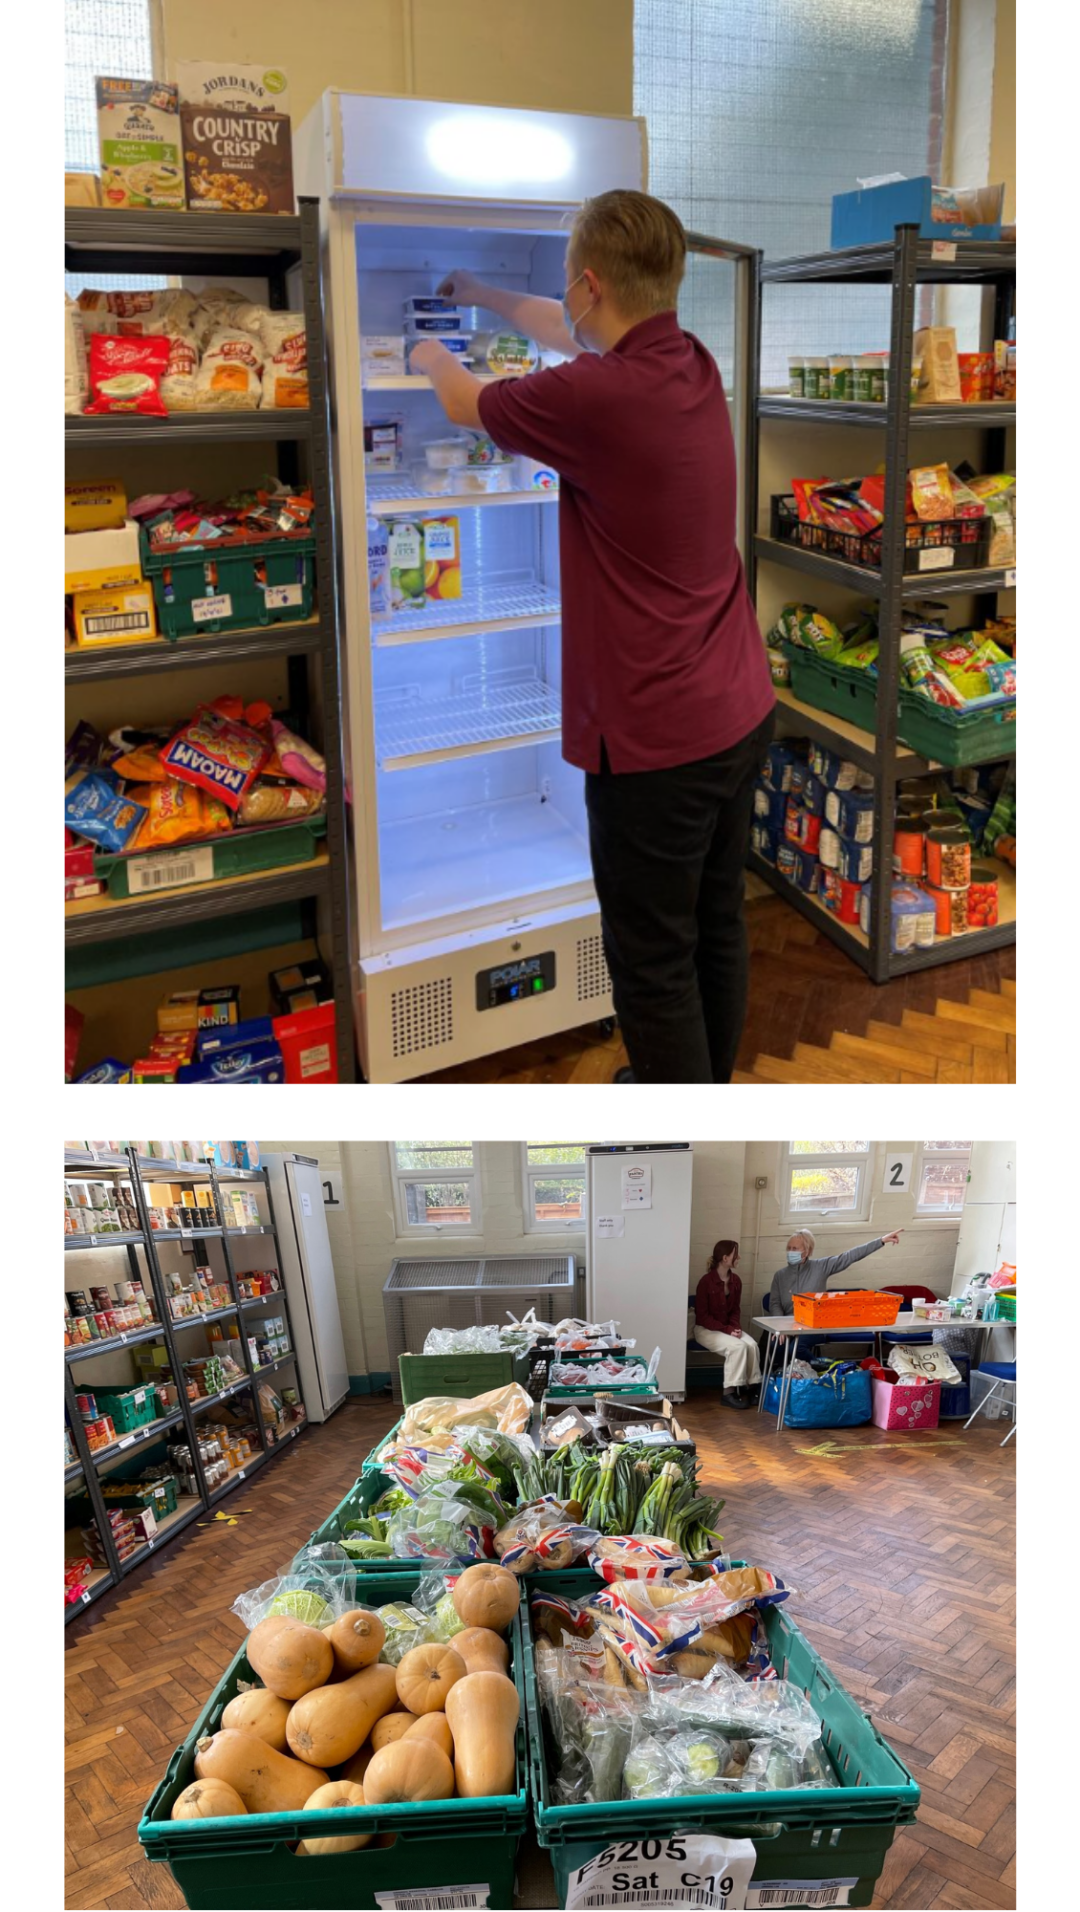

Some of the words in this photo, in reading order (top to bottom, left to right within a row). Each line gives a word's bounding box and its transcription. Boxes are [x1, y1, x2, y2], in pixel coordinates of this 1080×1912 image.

[102, 79, 132, 92] FREE
[203, 76, 265, 97] JORDANS
[193, 116, 280, 146] COUNTRY
[174, 744, 243, 789] MAOAM
[490, 959, 541, 987] POLAR
[198, 1016, 228, 1027] KIND
[889, 1162, 905, 1186] 2
[322, 1180, 340, 1204] 1
[902, 1346, 940, 1361] BOER
[576, 1839, 687, 1885] F5205
[612, 1872, 659, 1892] Sat
[681, 1873, 734, 1896] C19
